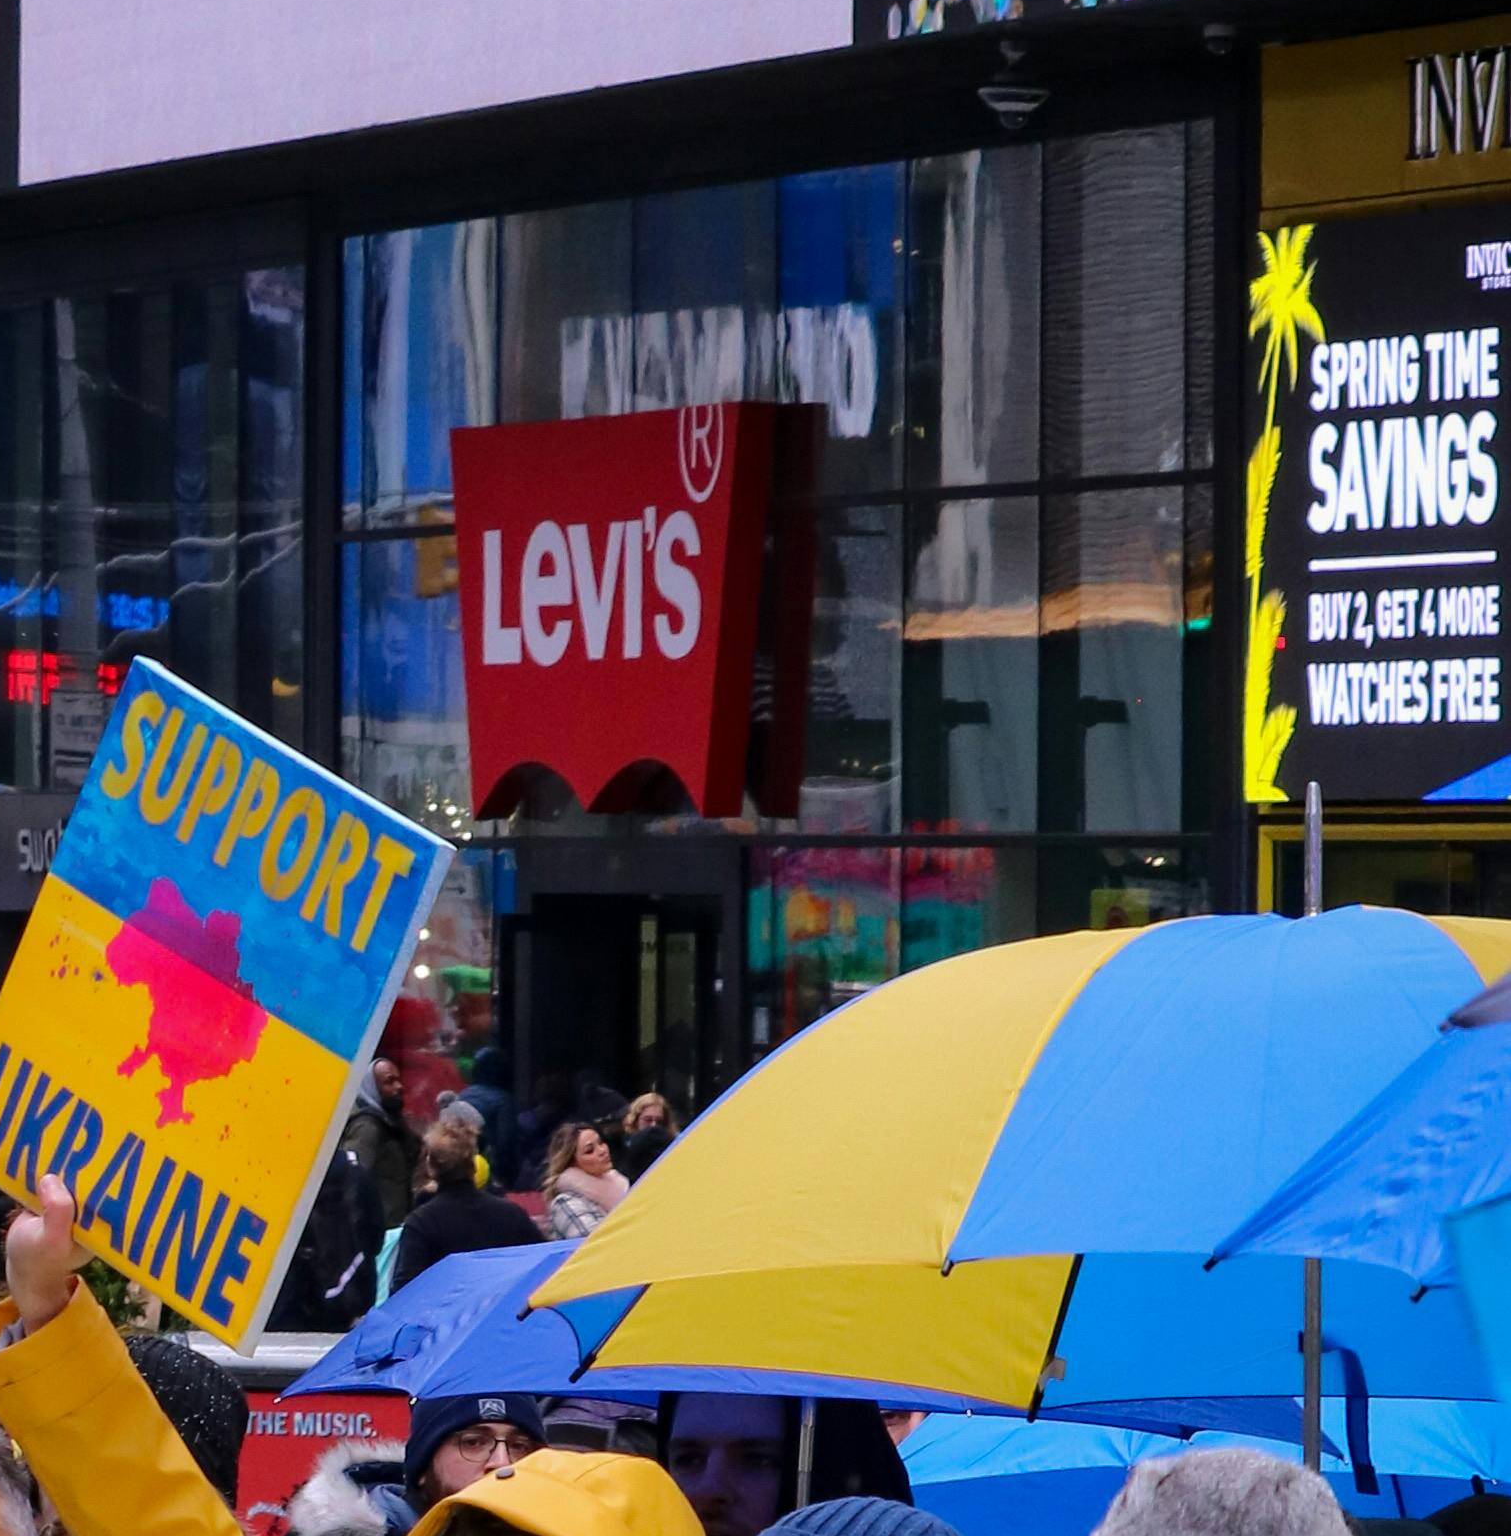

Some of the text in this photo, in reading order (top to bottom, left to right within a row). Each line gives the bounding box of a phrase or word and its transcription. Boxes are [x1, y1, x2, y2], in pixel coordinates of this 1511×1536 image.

[1412, 50, 1511, 157] INV
[1309, 326, 1500, 412] SPRING TIME
[1306, 410, 1498, 534] SAVINGS
[1308, 590, 1352, 643] BUY
[1375, 586, 1420, 639] GET
[1420, 586, 1436, 638] 4
[1439, 584, 1500, 637] MORE
[1307, 657, 1501, 726] WATCHES FREE
[101, 690, 416, 954] SUPPORT
[246, 1410, 377, 1437] THE MUSIC.
